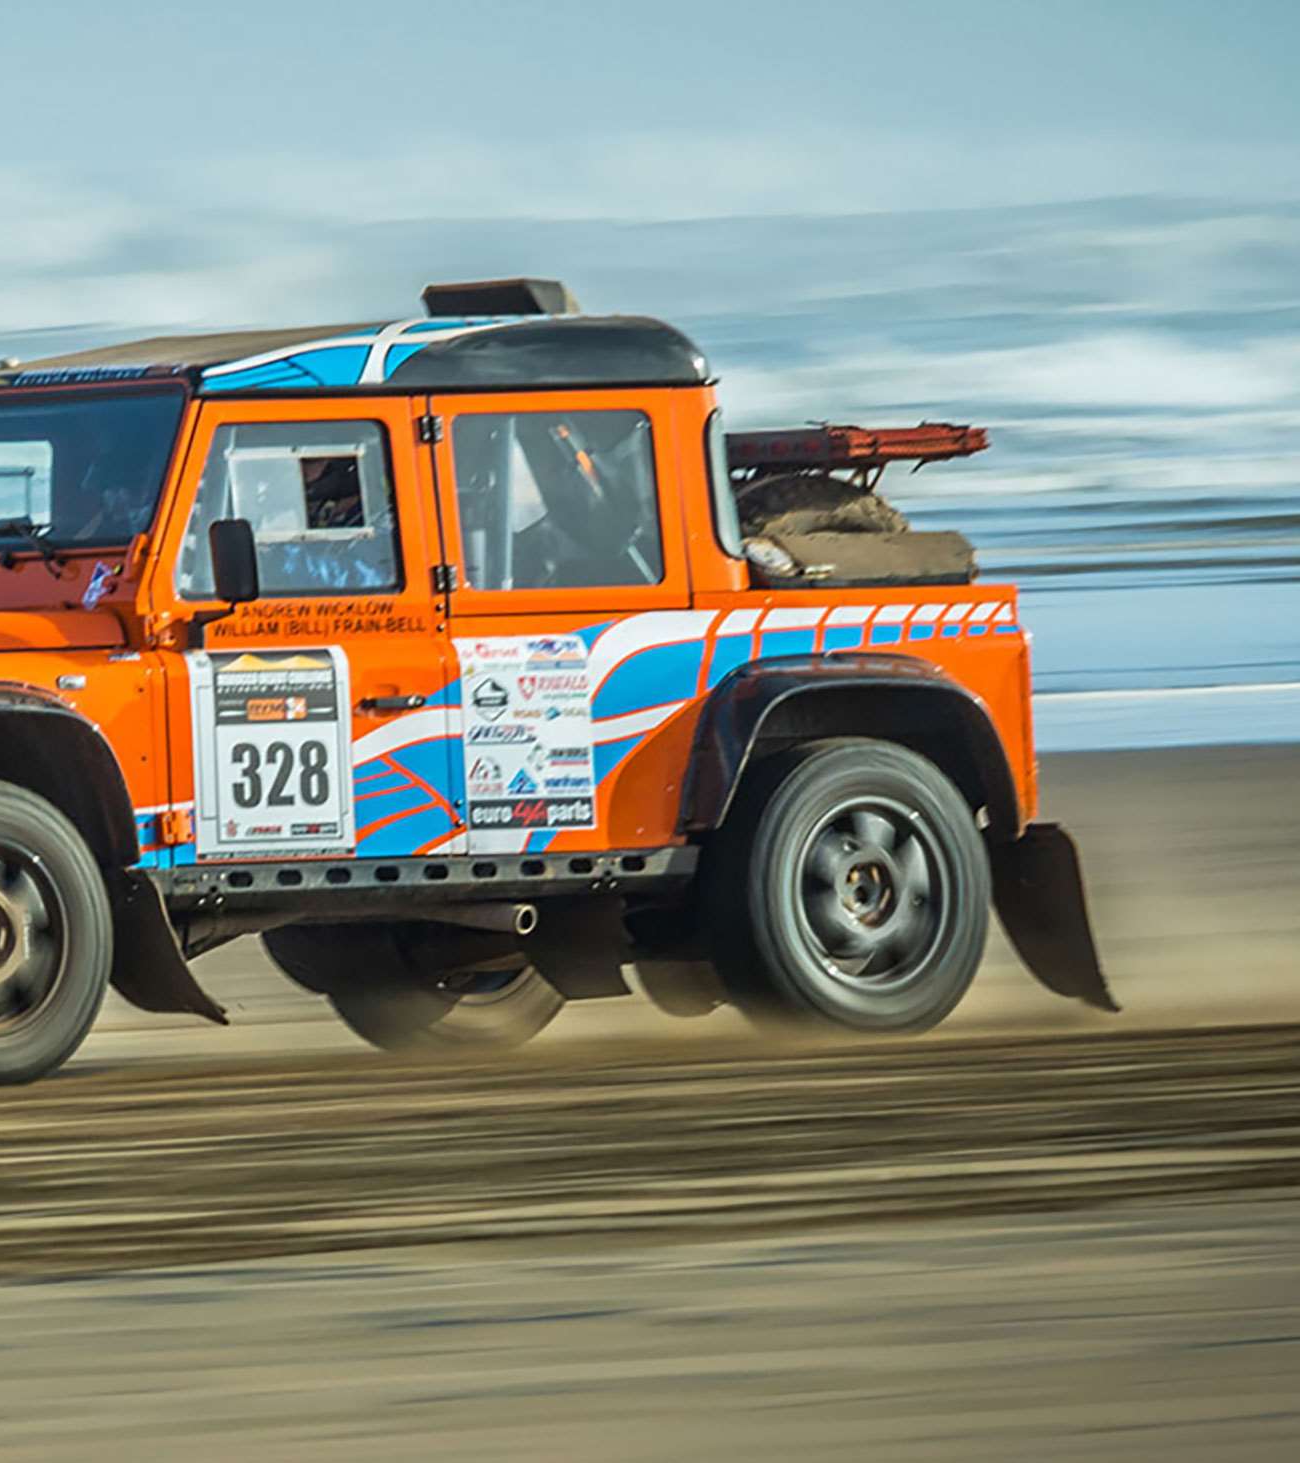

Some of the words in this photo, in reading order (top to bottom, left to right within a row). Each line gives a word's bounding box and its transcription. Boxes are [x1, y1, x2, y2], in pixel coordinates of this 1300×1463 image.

[241, 603, 310, 618] ANDREW
[316, 601, 394, 616] WICKLOW
[214, 621, 279, 637] WILLIAM
[284, 618, 330, 637] (BILL)
[333, 616, 426, 634] FRAIN-BELL
[231, 740, 330, 808] 328
